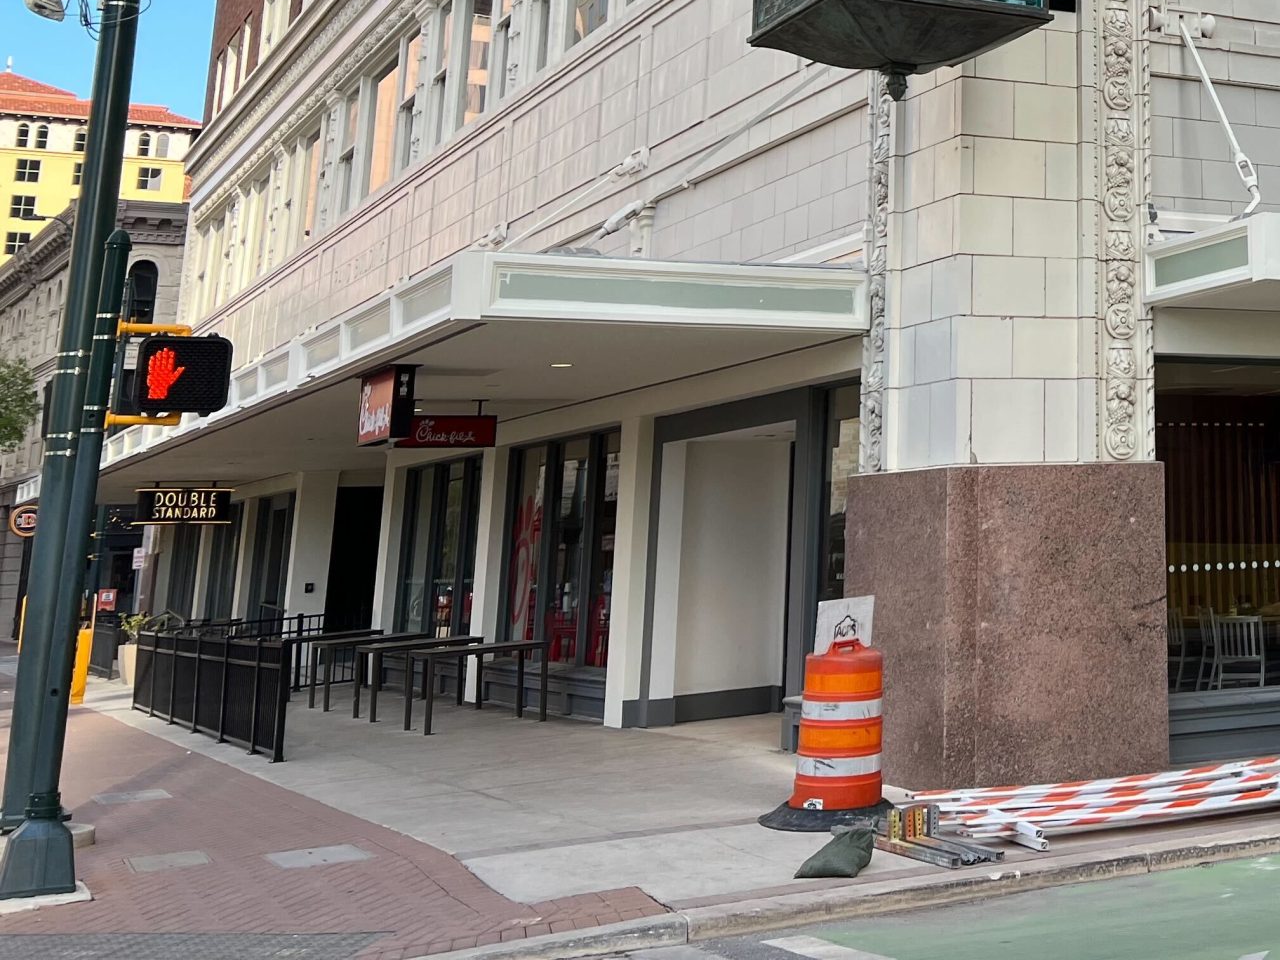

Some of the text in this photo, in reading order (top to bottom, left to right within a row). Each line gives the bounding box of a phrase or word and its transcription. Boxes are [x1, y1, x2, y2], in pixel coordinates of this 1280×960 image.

[415, 420, 476, 444] Chick-fil-A
[155, 492, 217, 506] DOUBLE
[152, 507, 216, 519] STANDARD
